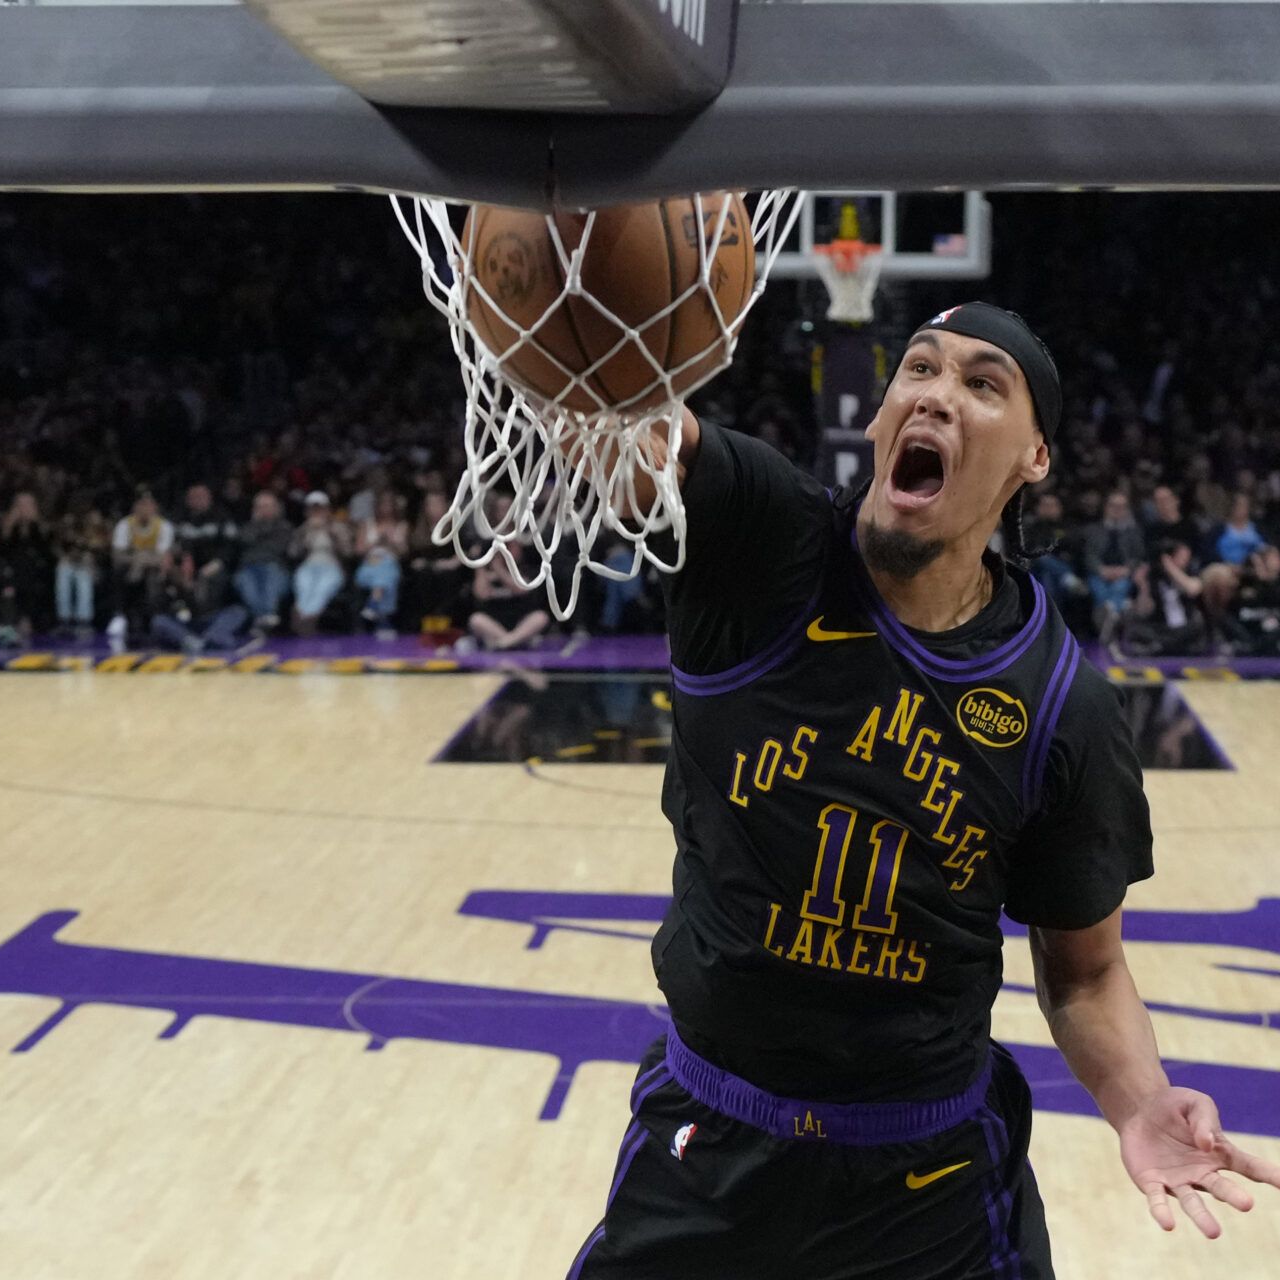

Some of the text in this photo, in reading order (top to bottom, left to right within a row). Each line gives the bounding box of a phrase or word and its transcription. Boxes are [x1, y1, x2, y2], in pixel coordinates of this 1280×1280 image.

[964, 696, 1023, 735] bibigo
[729, 687, 988, 891] LOS ANGELES
[799, 802, 910, 935] 11
[763, 902, 929, 983] LAKERS
[793, 1110, 827, 1138] LAL
